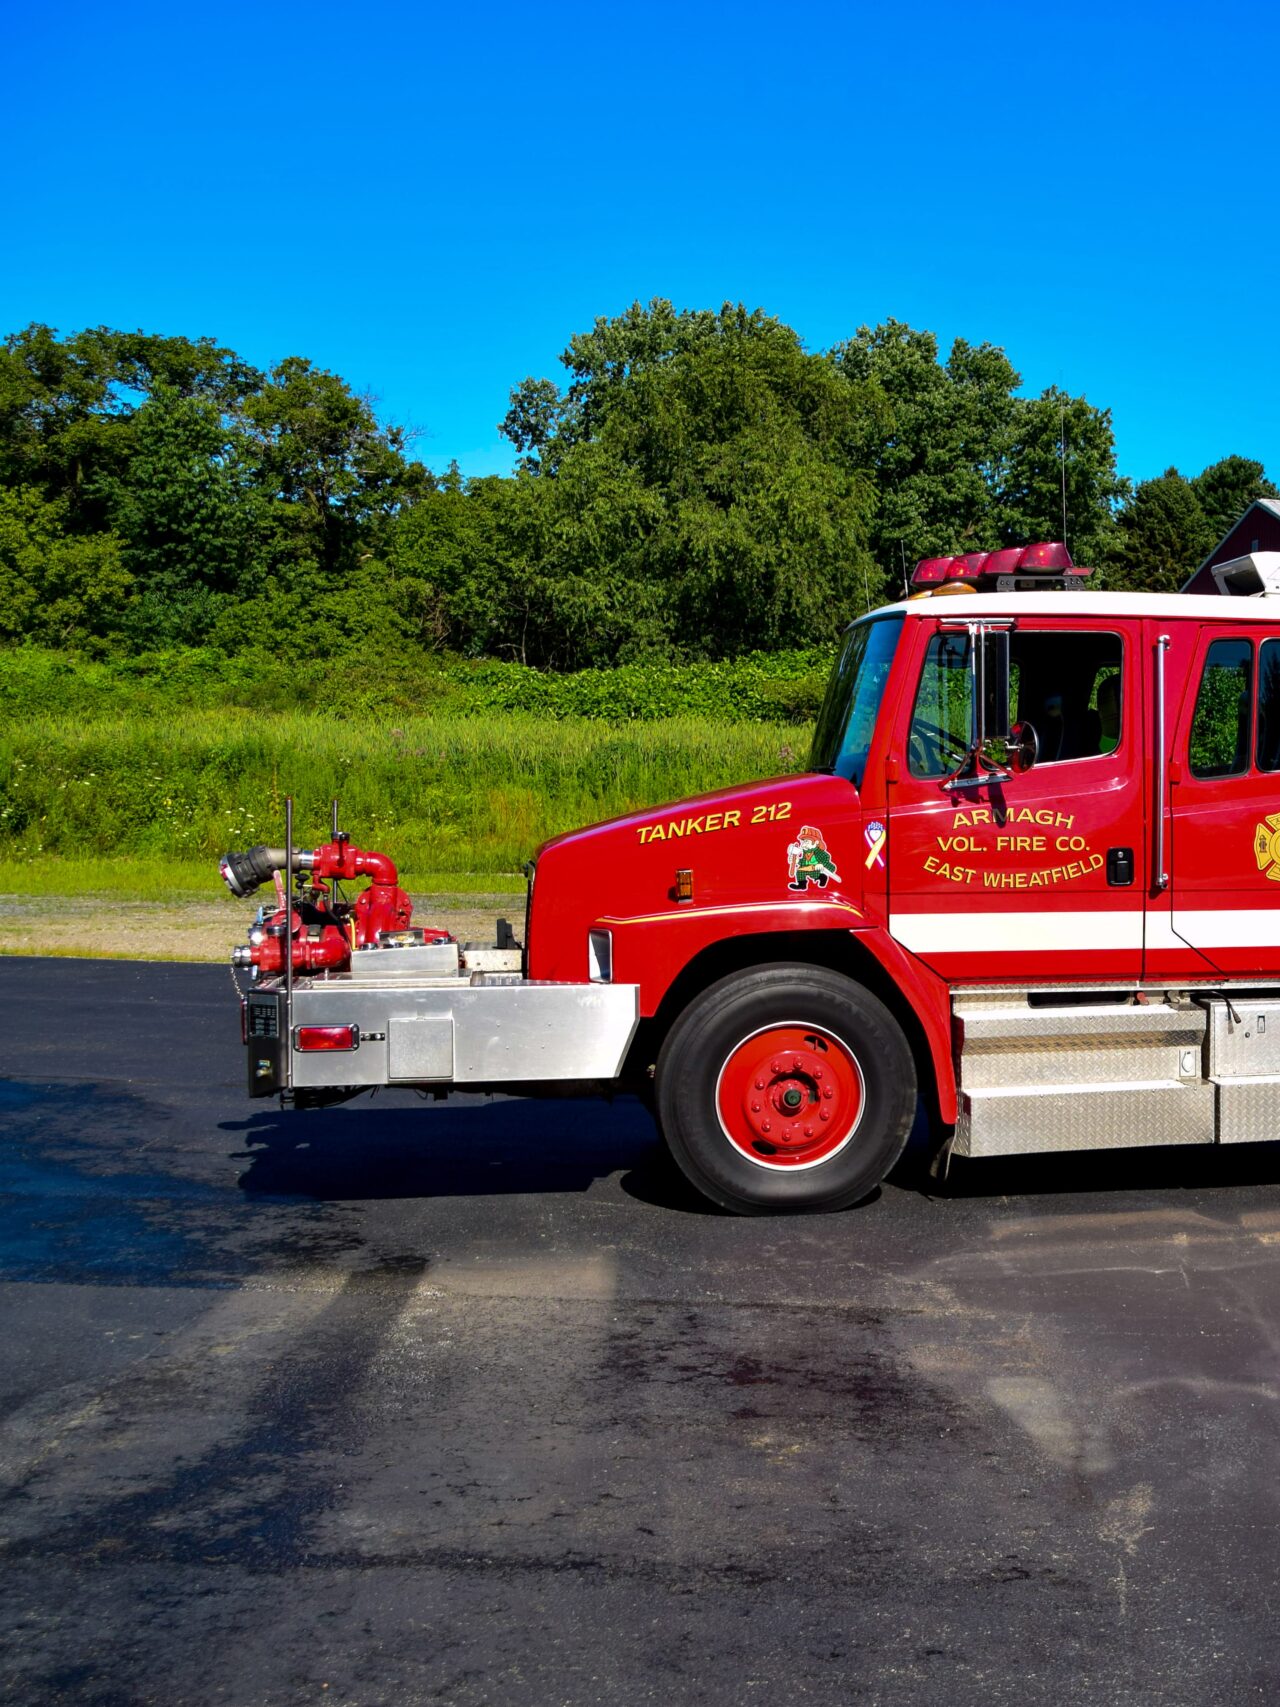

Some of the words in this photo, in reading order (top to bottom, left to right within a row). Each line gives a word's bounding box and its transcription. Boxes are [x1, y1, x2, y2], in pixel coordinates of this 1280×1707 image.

[636, 810, 742, 844] TANKER
[750, 801, 793, 824] 212
[952, 807, 1075, 830] ARMAGH
[937, 836, 988, 852] VOL.
[996, 836, 1047, 851] FIRE
[1055, 836, 1091, 852] CO.
[922, 855, 977, 885] EAST
[982, 853, 1105, 889] WHEATFIELD
